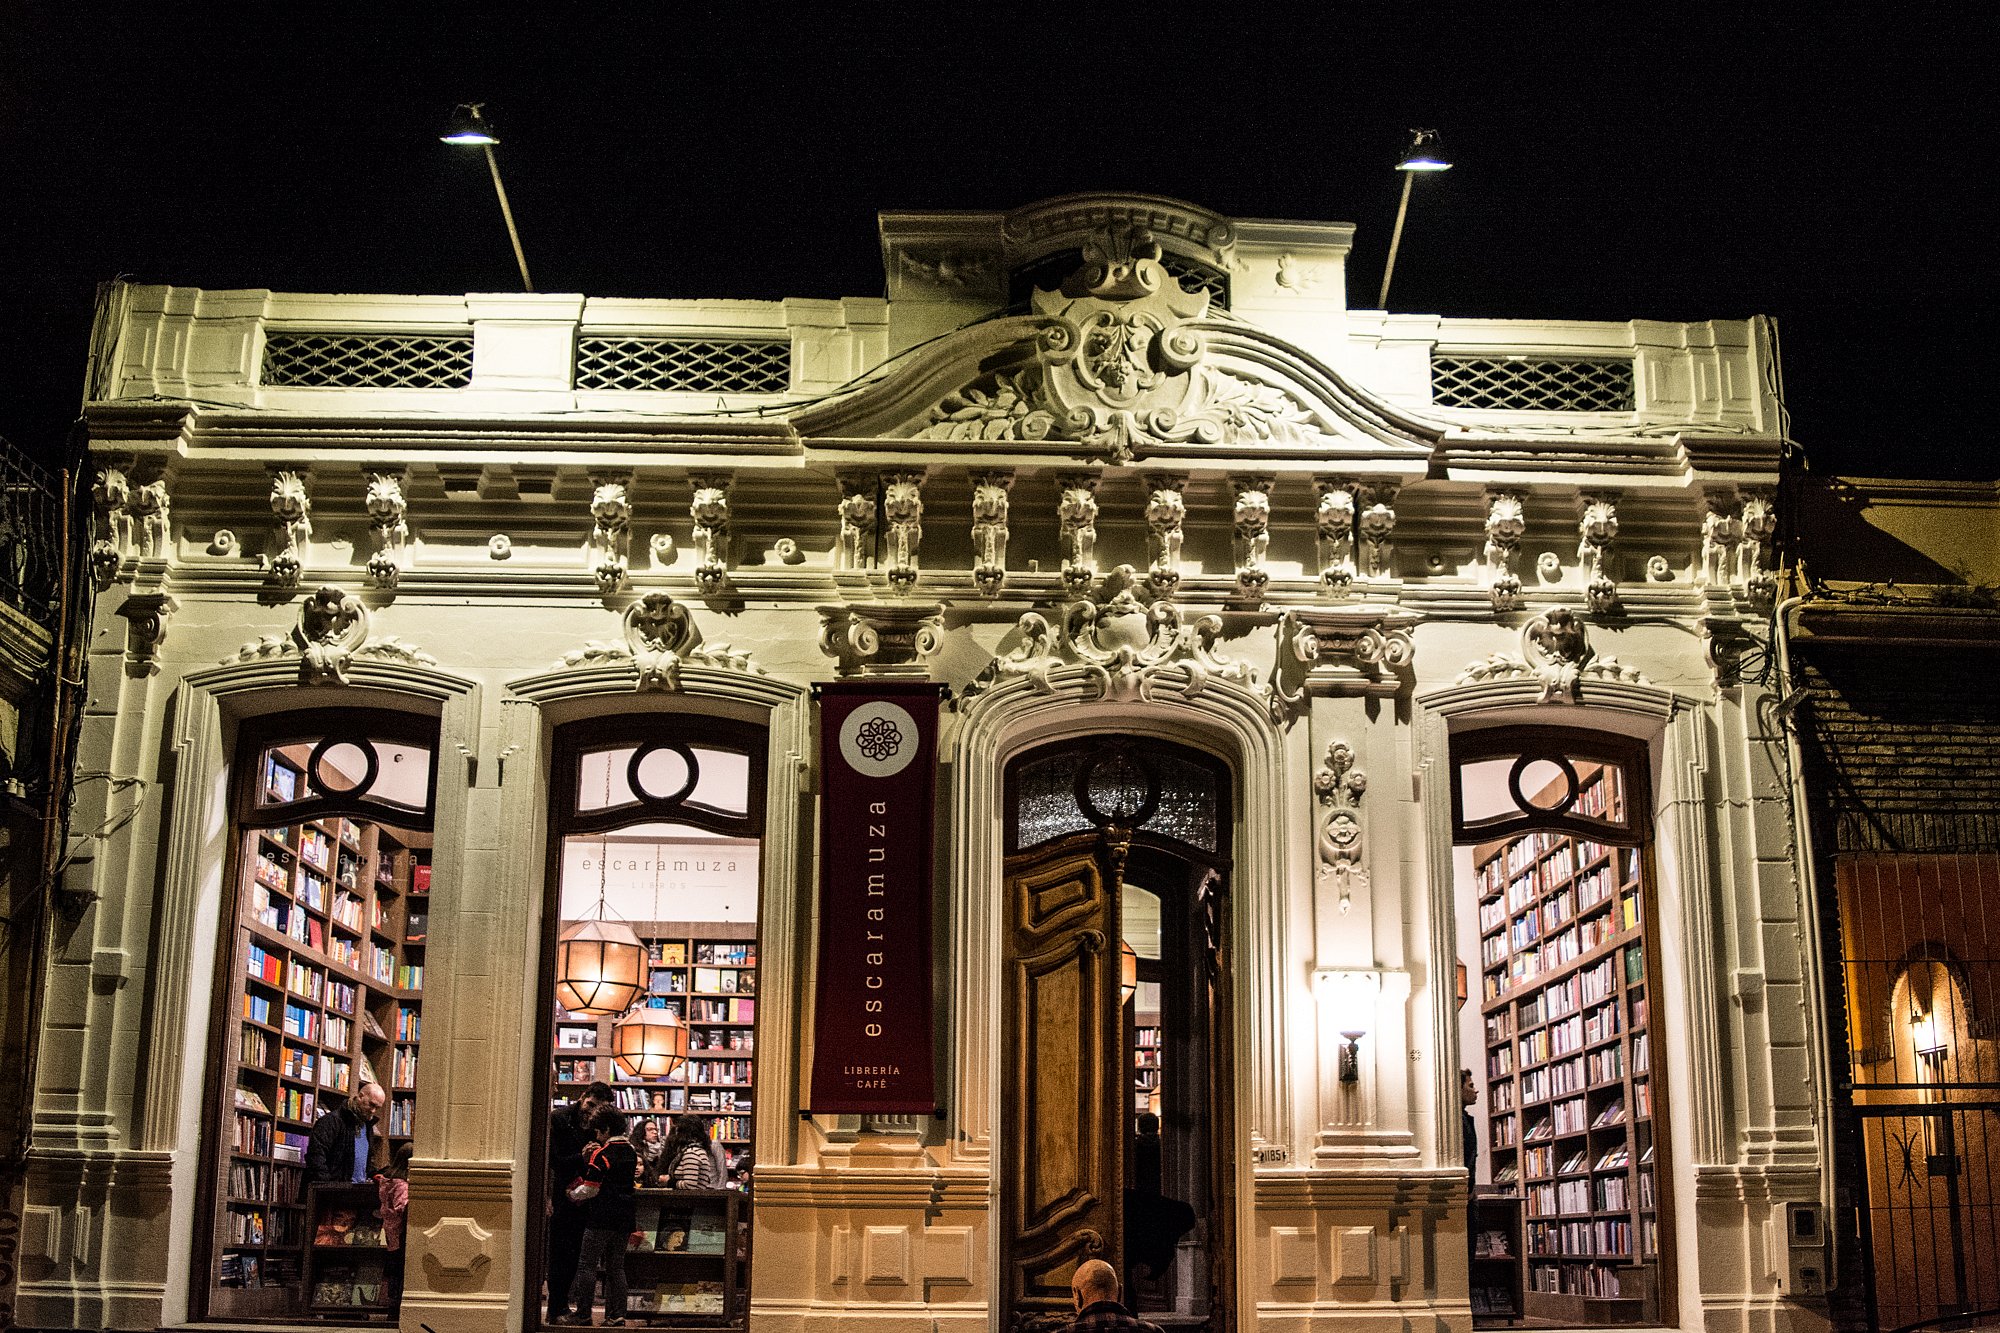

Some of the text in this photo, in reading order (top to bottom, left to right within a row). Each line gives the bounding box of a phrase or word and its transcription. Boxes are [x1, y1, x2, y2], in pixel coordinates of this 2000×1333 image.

[582, 859, 737, 872] escaramuza
[865, 801, 886, 1037] escaramuza
[844, 1064, 900, 1075] LIBRERÍA
[857, 1078, 887, 1089] CAFÉ
[1264, 1149, 1281, 1162] 1185
